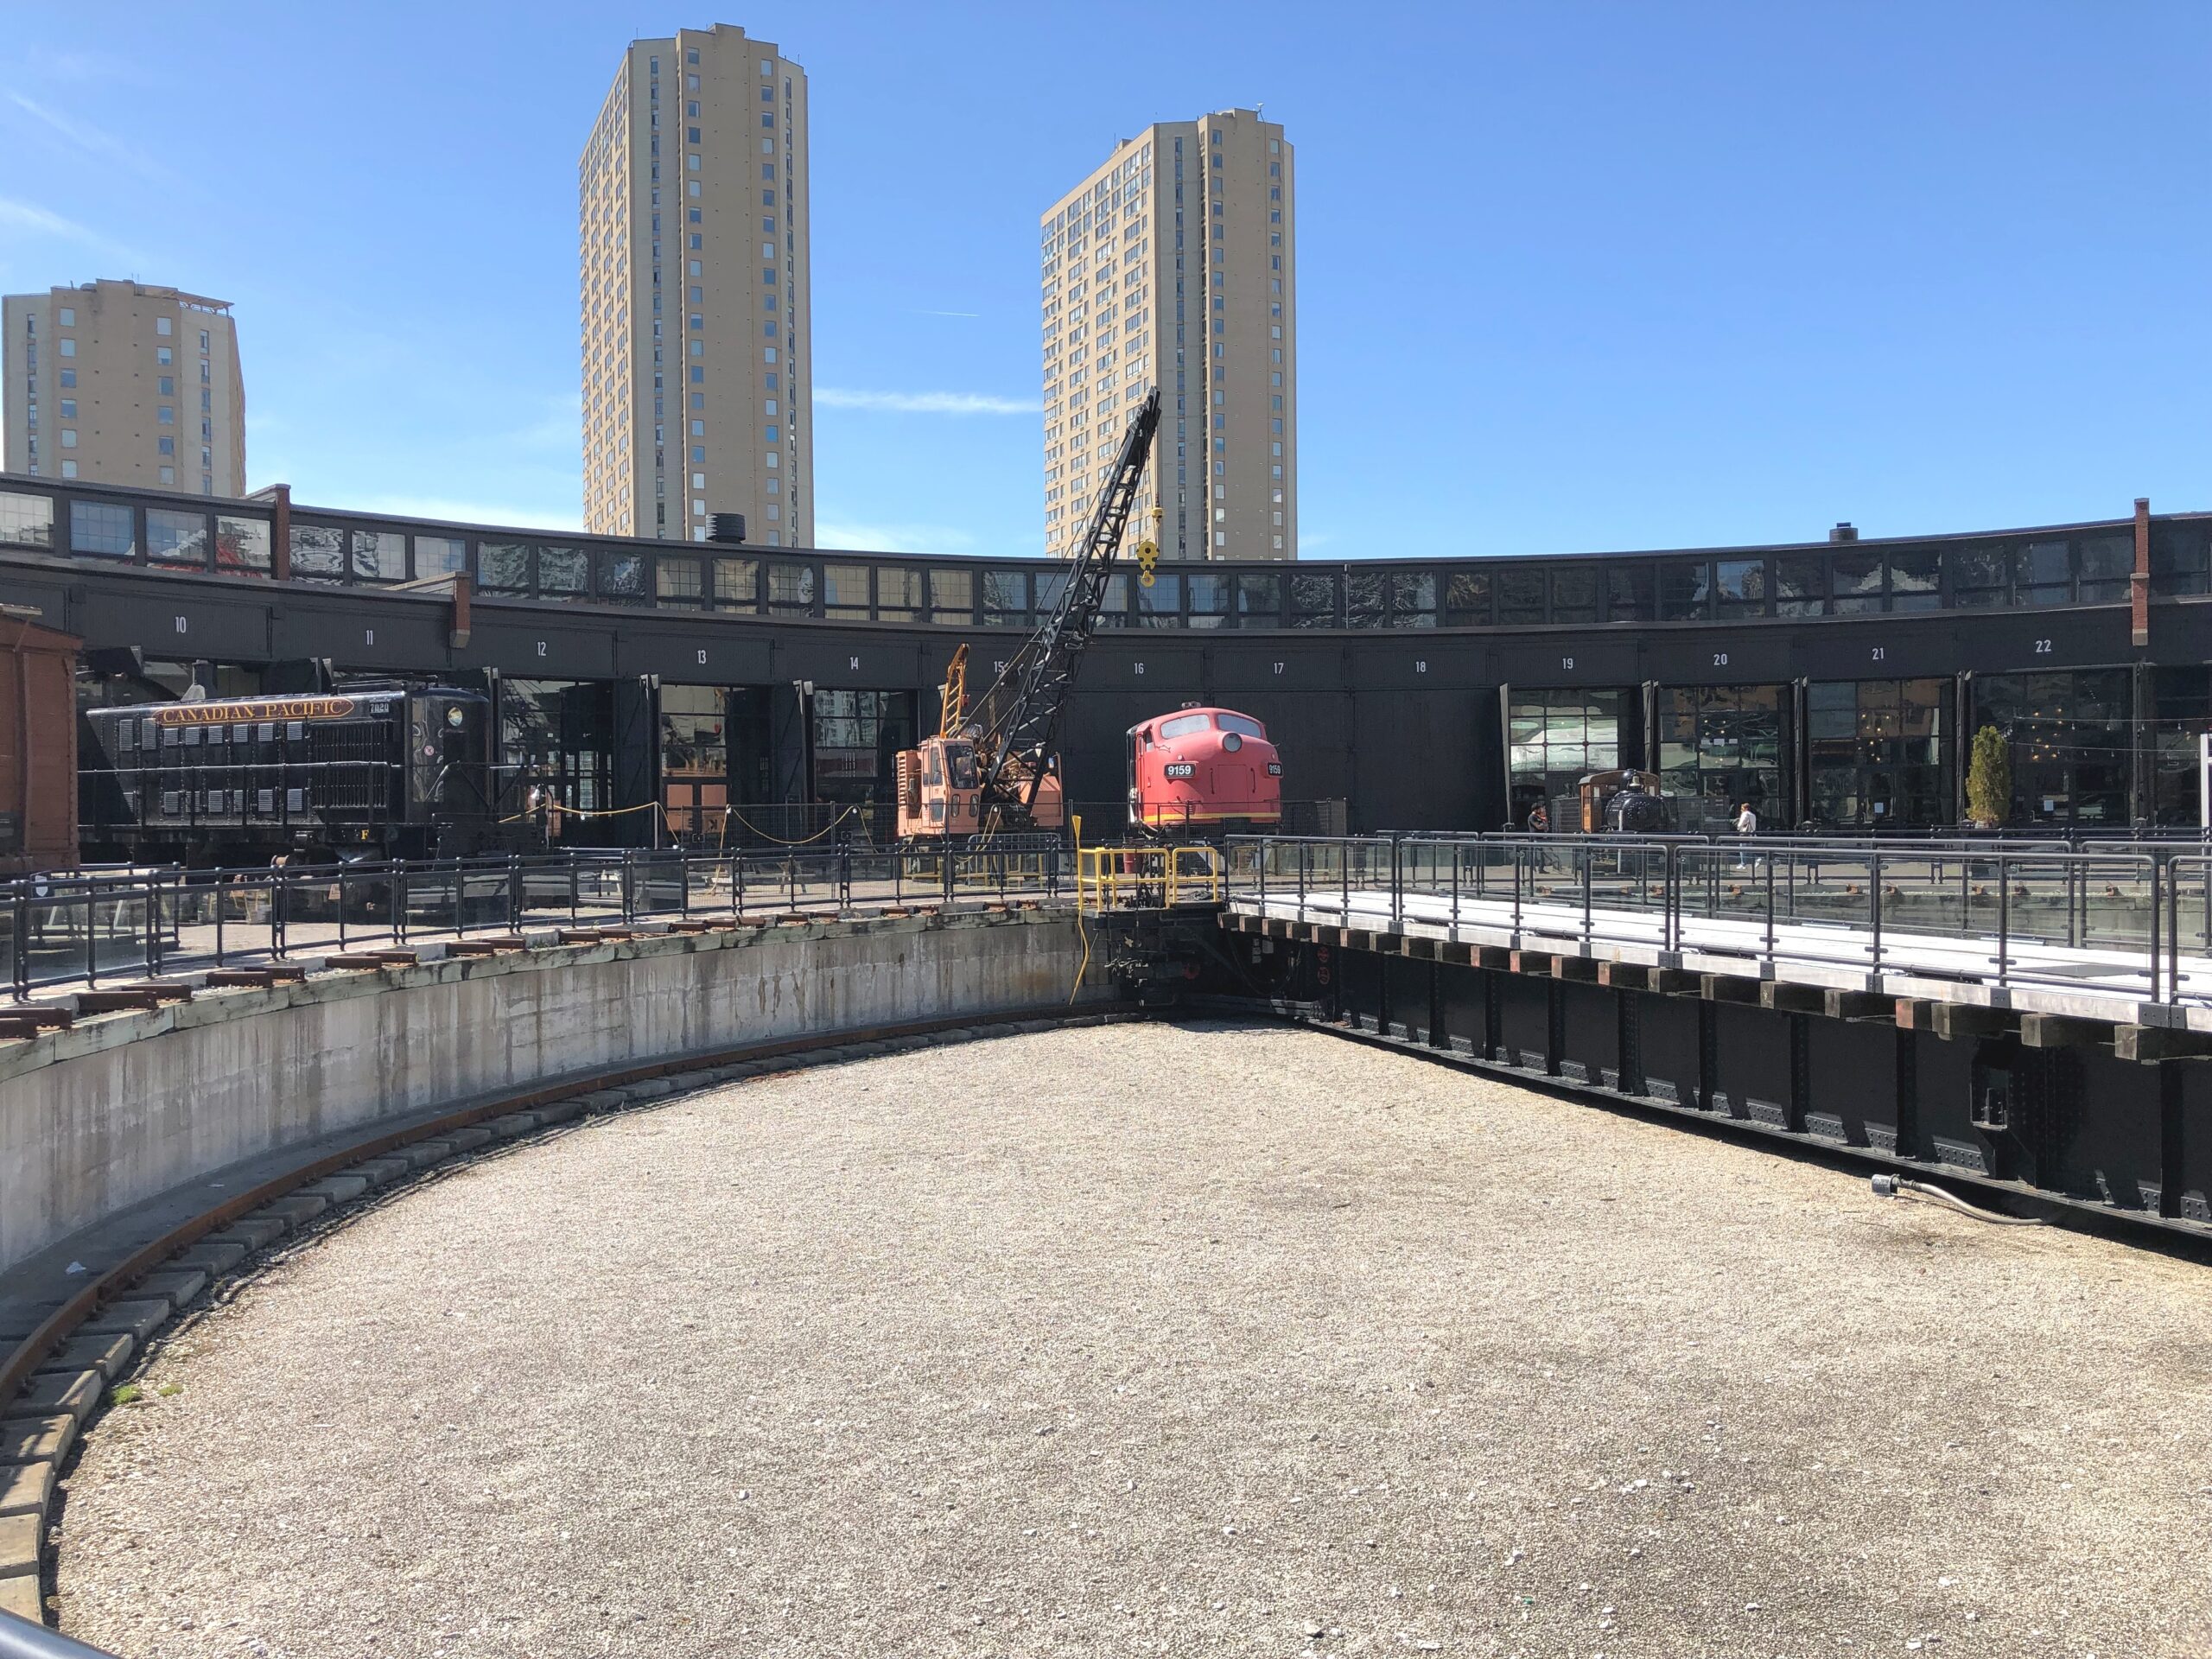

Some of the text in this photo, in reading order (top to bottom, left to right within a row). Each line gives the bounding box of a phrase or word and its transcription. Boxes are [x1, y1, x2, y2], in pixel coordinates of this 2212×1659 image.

[175, 616, 187, 633] 10
[365, 629, 373, 645] 11
[537, 641, 547, 657] 12
[2035, 639, 2052, 653] 22
[697, 649, 707, 664] 13
[1713, 653, 1728, 666] 20
[1872, 647, 1885, 660] 21
[849, 657, 859, 671] 14
[994, 660, 1005, 673] 15
[1134, 662, 1144, 675] 16
[1274, 662, 1284, 674] 17
[1415, 661, 1427, 673] 18
[1562, 658, 1573, 670] 19
[163, 700, 343, 723] CANADIAN PACIFIC
[1167, 765, 1192, 776] 9159
[1268, 764, 1281, 774] 9159
[360, 829, 370, 841] F
